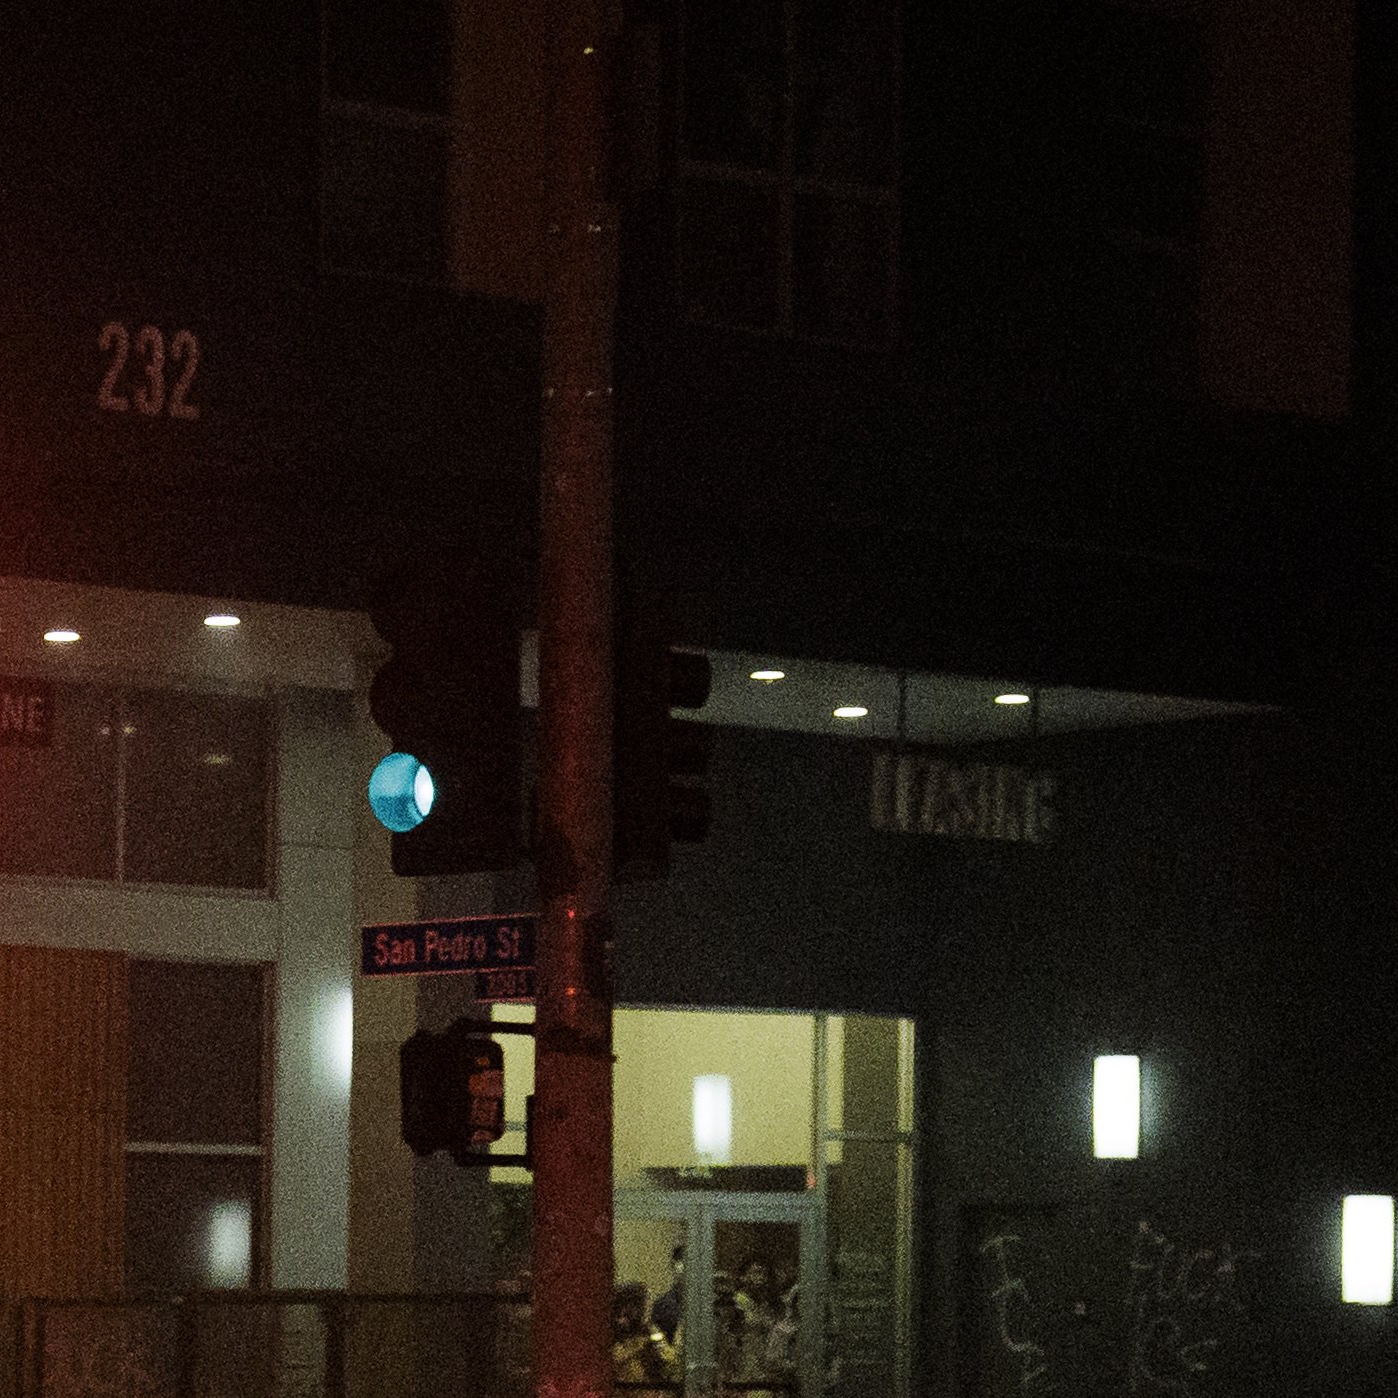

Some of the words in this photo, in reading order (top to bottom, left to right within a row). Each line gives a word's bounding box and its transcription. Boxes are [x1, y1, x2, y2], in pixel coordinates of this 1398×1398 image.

[98, 321, 200, 419] 232
[373, 931, 417, 967] San
[423, 927, 488, 963] Pedro
[496, 925, 521, 960] St
